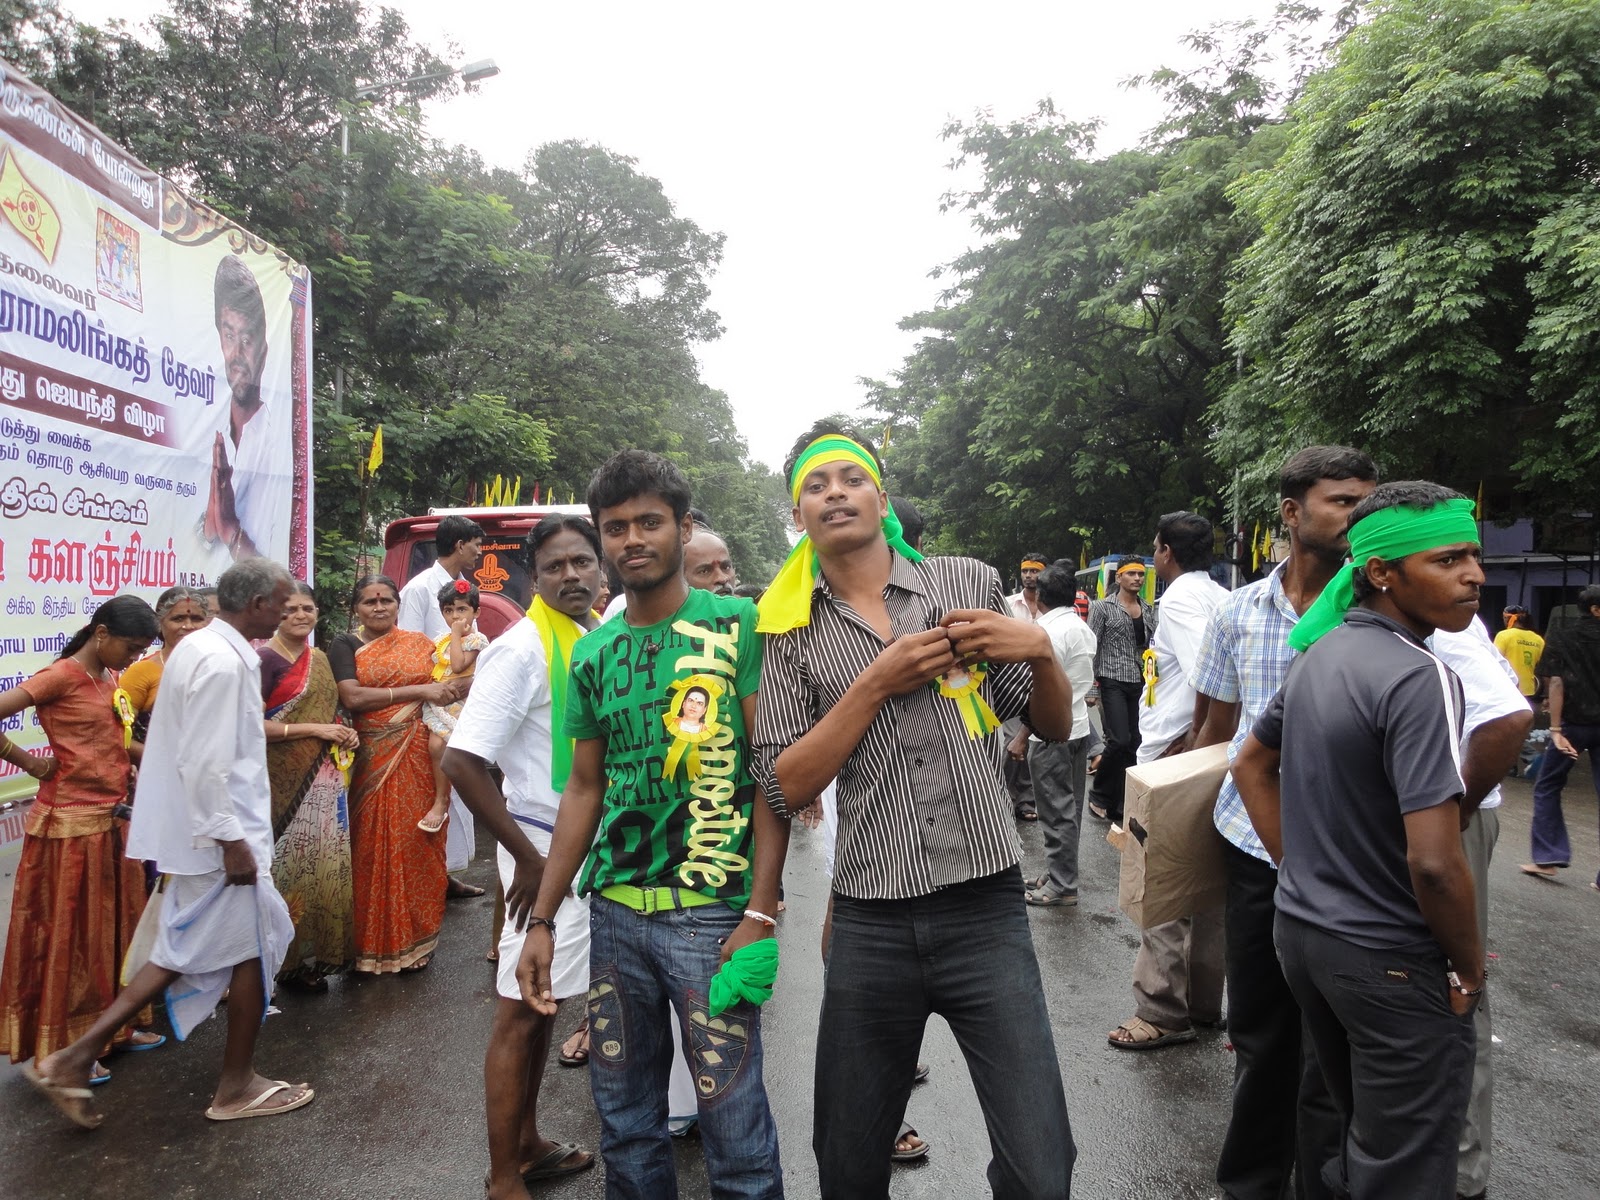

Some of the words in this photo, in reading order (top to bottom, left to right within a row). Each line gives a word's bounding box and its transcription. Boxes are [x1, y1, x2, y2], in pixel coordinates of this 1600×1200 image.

[92, 138, 154, 209] போன்றது
[161, 345, 216, 406] தேவர்
[36, 376, 116, 424] ஜெயந்தி
[124, 402, 166, 437] விழா
[47, 430, 92, 452] வைக்க
[27, 449, 74, 475] தொட்டு
[79, 460, 129, 485] ஆசிபெற
[134, 473, 173, 490] வருகை
[176, 482, 197, 497] தரும்
[62, 486, 149, 526] சிங்கம்
[28, 529, 177, 597] களஞ்சியம்
[6, 596, 36, 616] அகில
[42, 595, 76, 620] இந்திய
